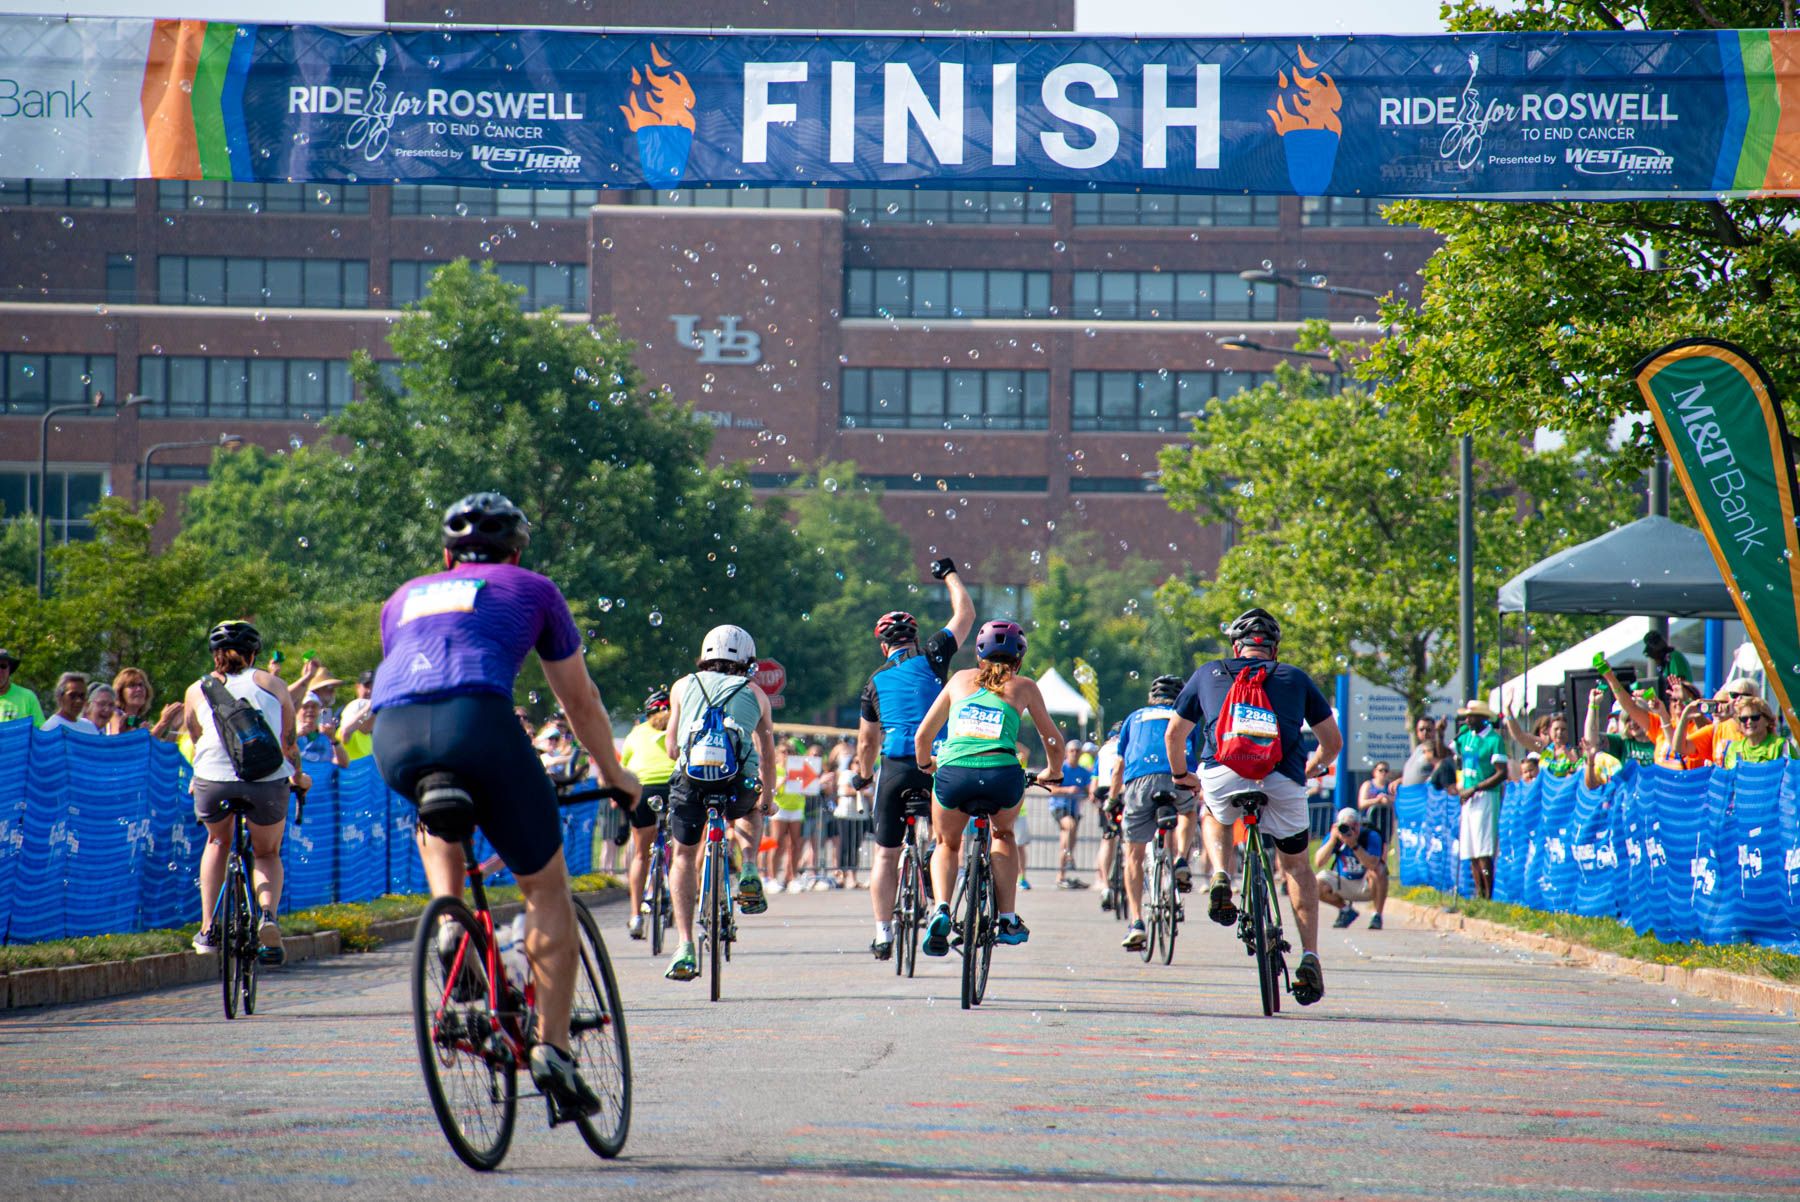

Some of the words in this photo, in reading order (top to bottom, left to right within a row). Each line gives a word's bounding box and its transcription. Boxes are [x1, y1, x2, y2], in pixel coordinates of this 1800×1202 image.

[0, 79, 93, 118] Bank
[288, 86, 363, 114] RIDE
[388, 91, 428, 128] for
[428, 89, 584, 120] ROSWELL
[1380, 97, 1457, 125] RIDE
[1480, 98, 1521, 134] for
[1521, 93, 1679, 121] ROSWELL
[427, 122, 446, 135] TO
[451, 123, 479, 137] END
[484, 123, 543, 139] CANCER
[742, 61, 1220, 169] FINISH
[1521, 128, 1541, 140] TO
[1544, 127, 1573, 140] END
[1578, 127, 1635, 140] CANCER
[395, 147, 448, 159] Presented
[450, 149, 463, 160] by
[472, 145, 530, 162] WEST
[526, 152, 582, 170] HERR
[1489, 154, 1541, 165] Presented
[1543, 154, 1557, 166] by
[1565, 147, 1622, 163] WEST
[1619, 154, 1675, 170] HERR
[667, 313, 763, 366] UB
[1671, 381, 1736, 467] M&T
[1710, 468, 1768, 556] Bank
[970, 709, 1000, 724] 2844
[1245, 709, 1274, 723] 2845
